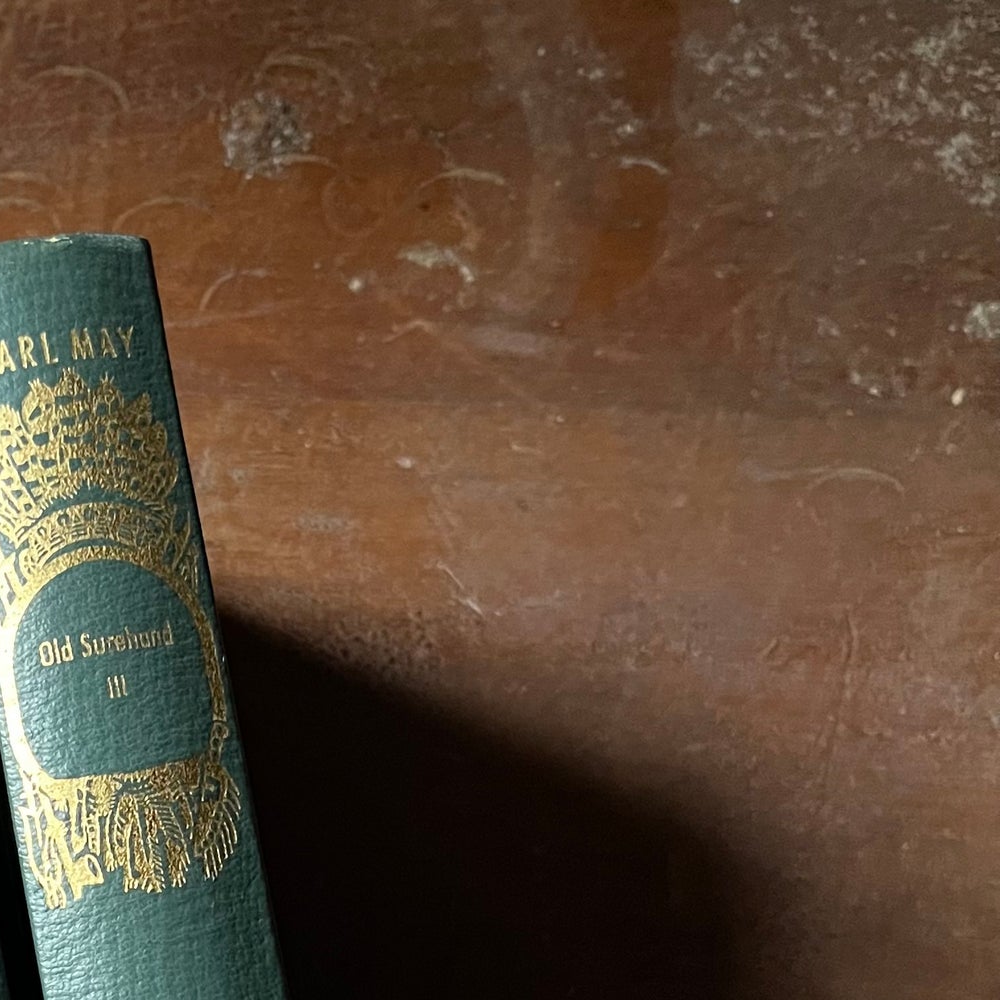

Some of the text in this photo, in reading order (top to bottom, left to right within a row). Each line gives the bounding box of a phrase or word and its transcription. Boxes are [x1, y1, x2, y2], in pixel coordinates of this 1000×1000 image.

[70, 326, 135, 360] MAY
[38, 622, 175, 667] Old Surehand
[107, 675, 127, 699] III
